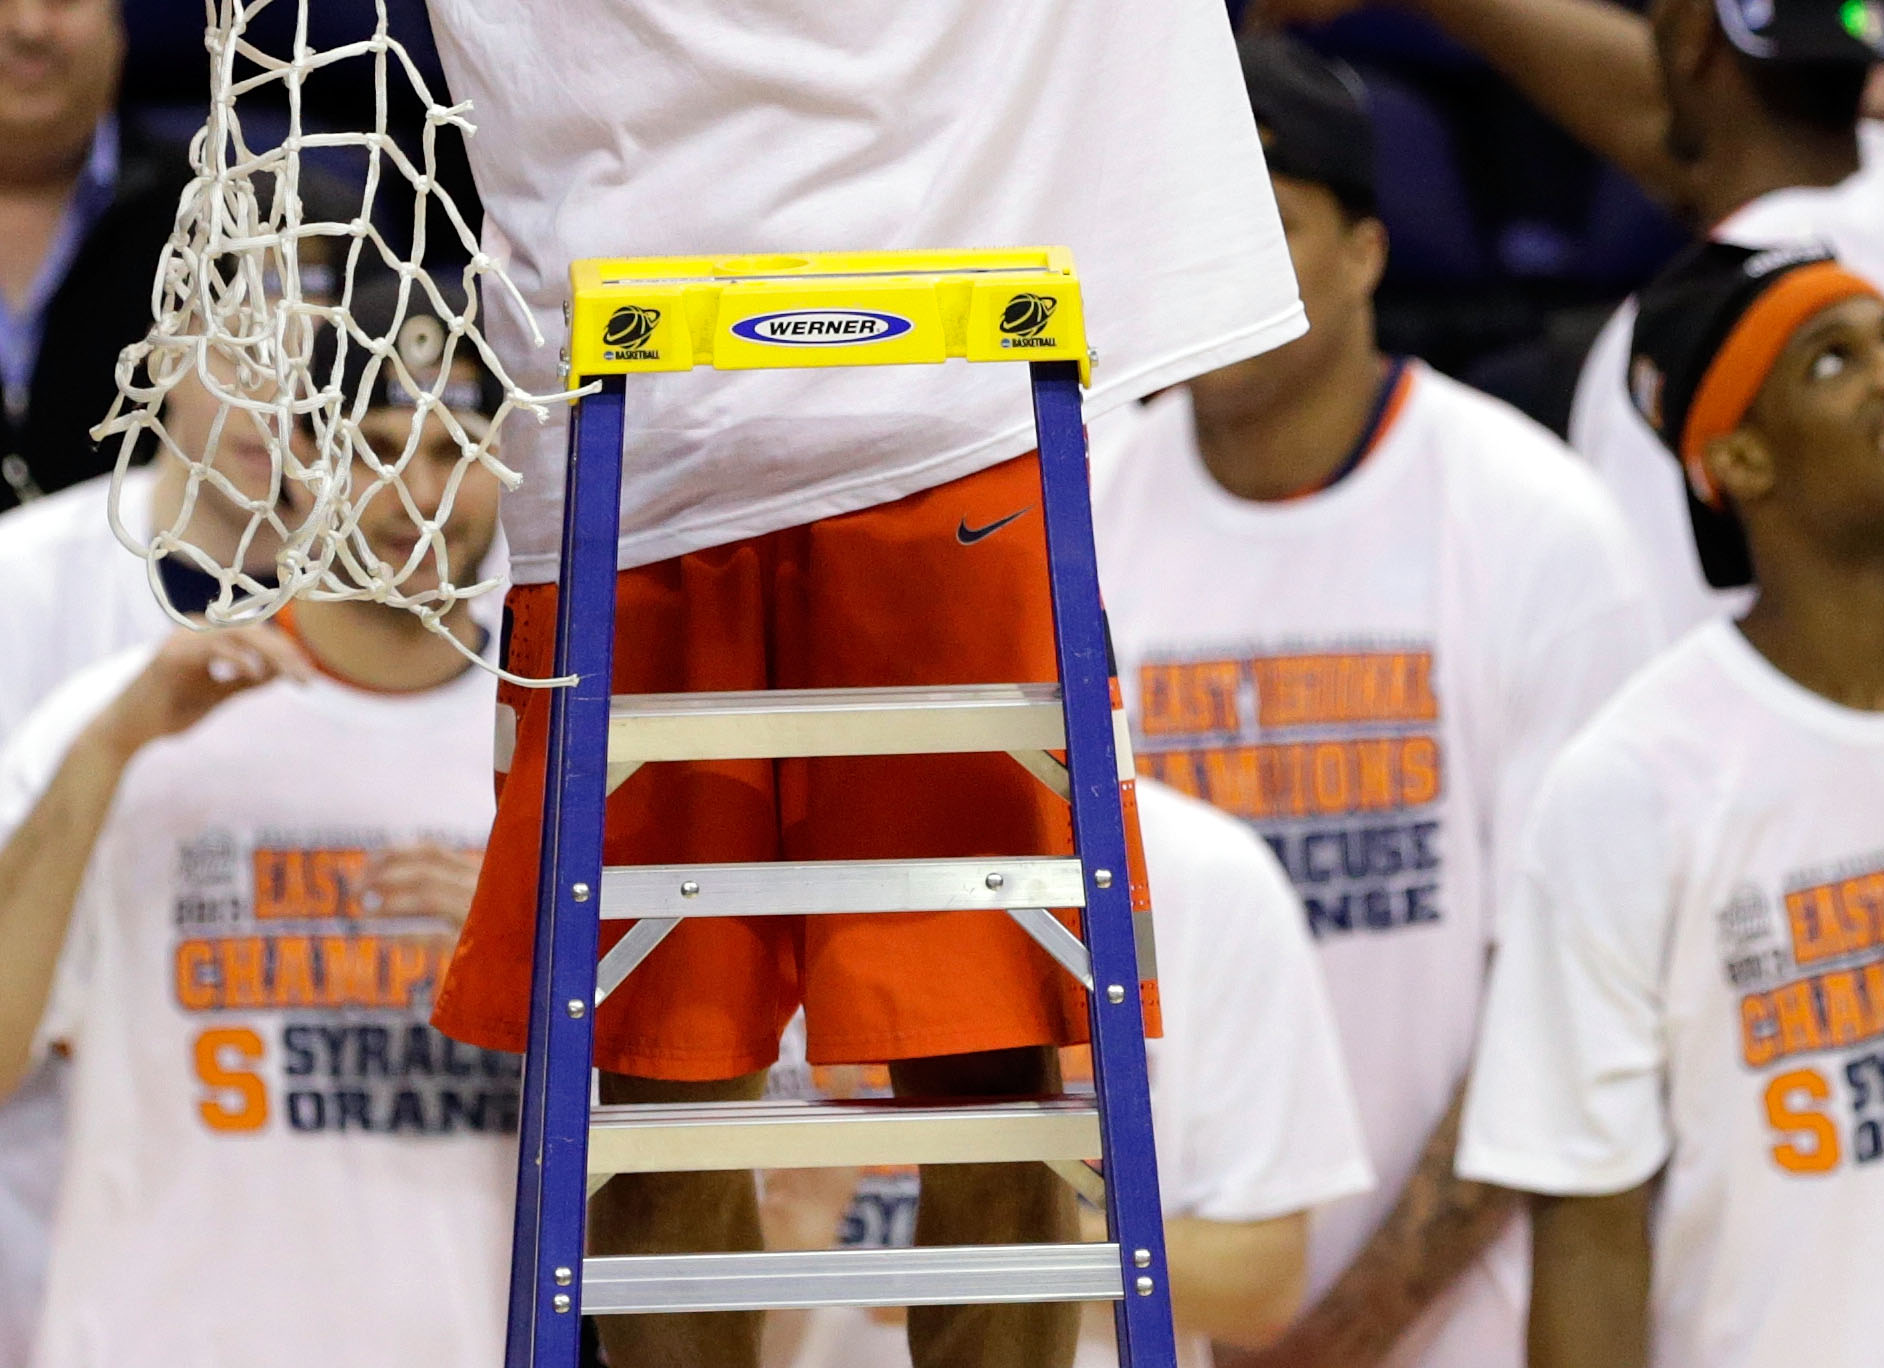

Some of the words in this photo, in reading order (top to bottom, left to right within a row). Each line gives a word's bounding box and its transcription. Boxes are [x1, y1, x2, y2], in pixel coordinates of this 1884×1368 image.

[769, 319, 877, 336] WERNER
[1011, 337, 1056, 348] BASKETBALL
[614, 349, 660, 360] BASKETBALL
[194, 1027, 270, 1133] S
[1764, 1068, 1842, 1175] S
